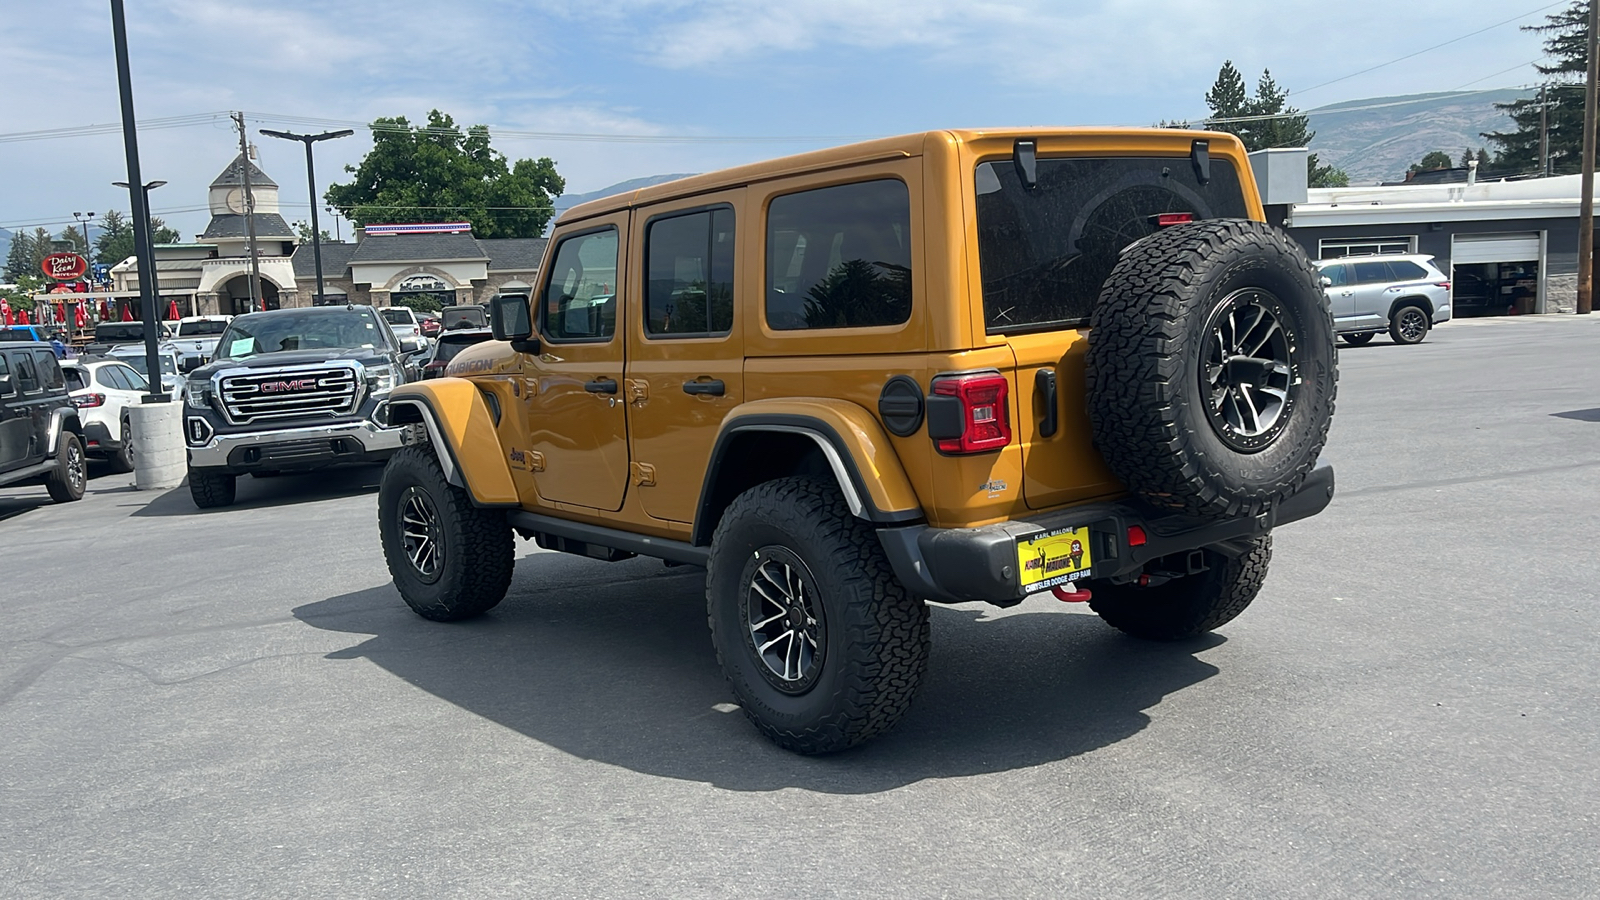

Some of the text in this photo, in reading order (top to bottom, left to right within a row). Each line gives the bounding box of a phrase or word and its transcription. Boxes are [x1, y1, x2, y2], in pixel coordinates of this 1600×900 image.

[49, 255, 76, 270] Dairy
[52, 263, 72, 275] Keen
[261, 379, 317, 393] GMC
[1034, 526, 1073, 541] KARL MALONE
[1072, 543, 1080, 552] 32
[1025, 580, 1050, 593] CHRYSLER
[1051, 575, 1068, 586] DODGE
[1068, 572, 1080, 581] JEEP
